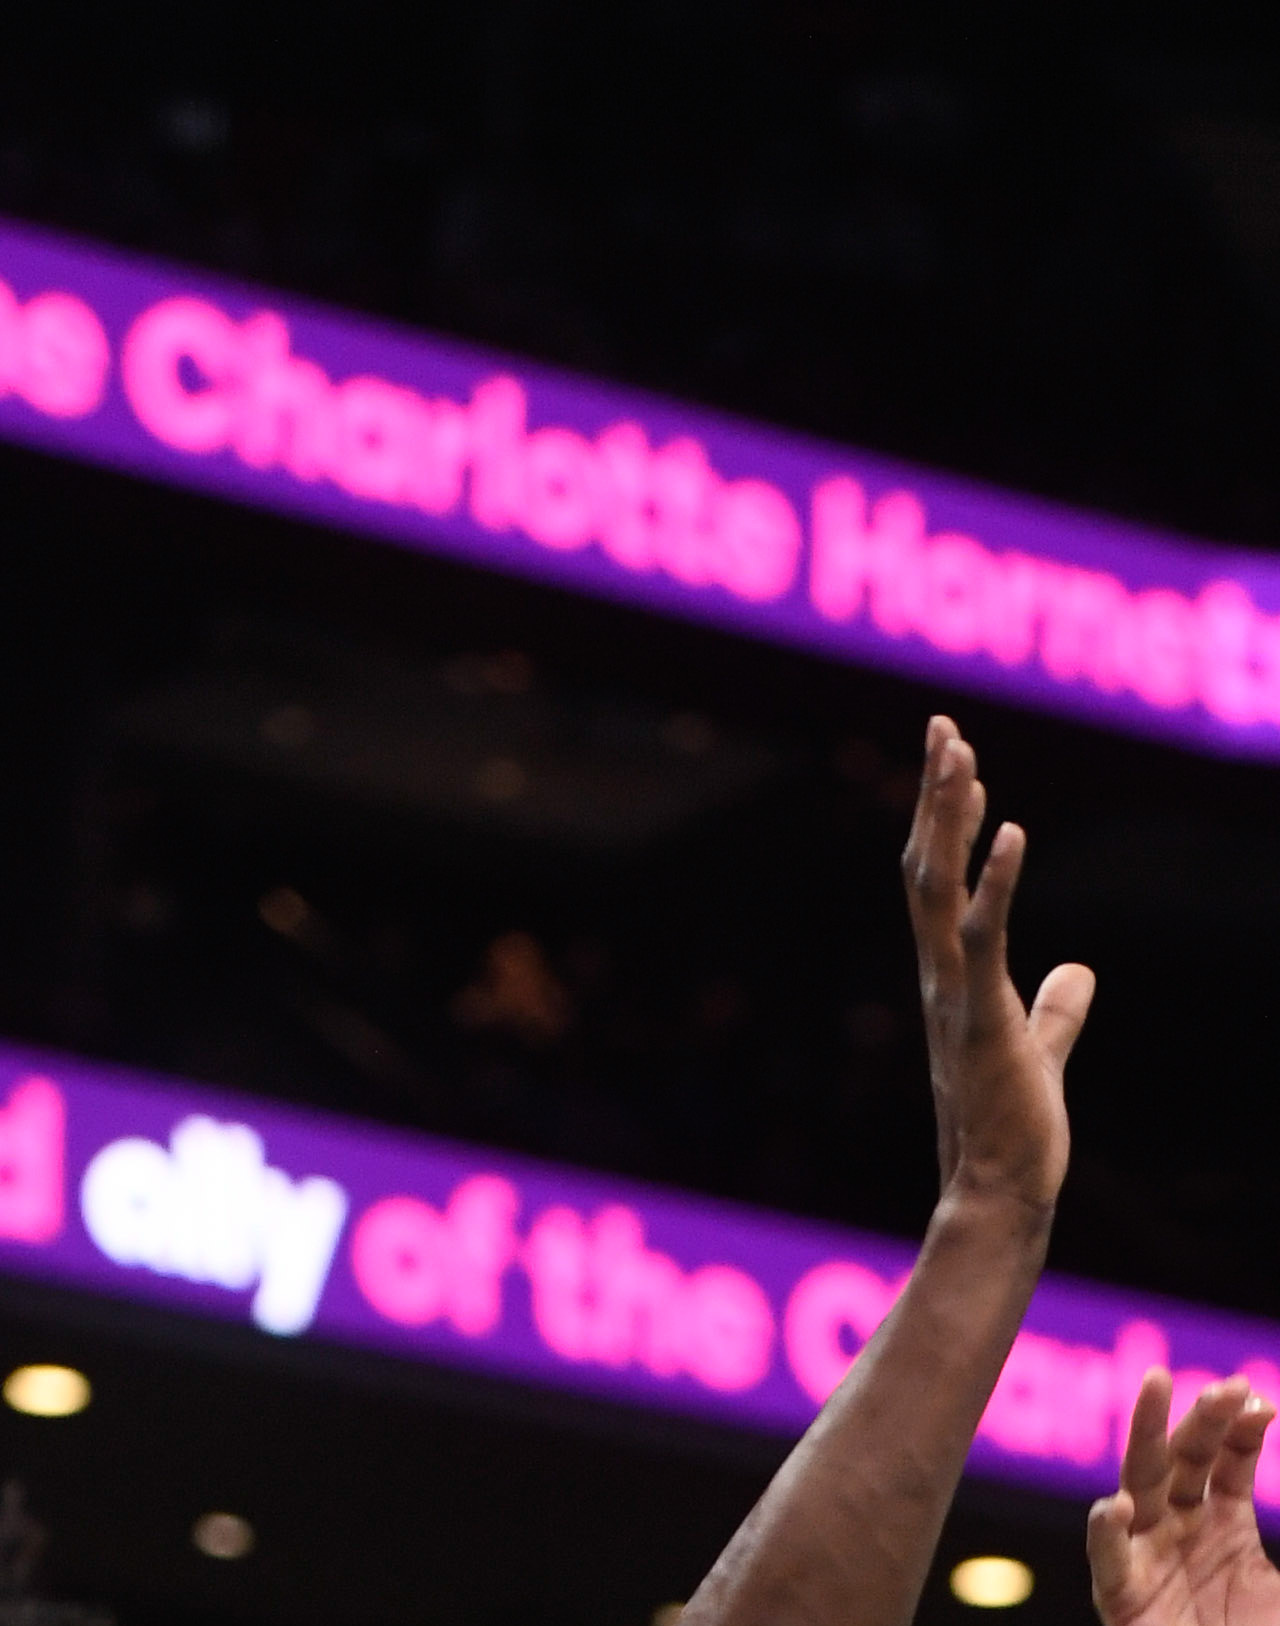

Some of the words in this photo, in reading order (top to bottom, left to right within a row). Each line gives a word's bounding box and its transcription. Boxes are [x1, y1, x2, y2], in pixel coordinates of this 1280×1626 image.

[122, 295, 800, 602] Charlotte
[80, 1113, 348, 1336] ally
[352, 1174, 520, 1338] of
[526, 1204, 775, 1393] the
